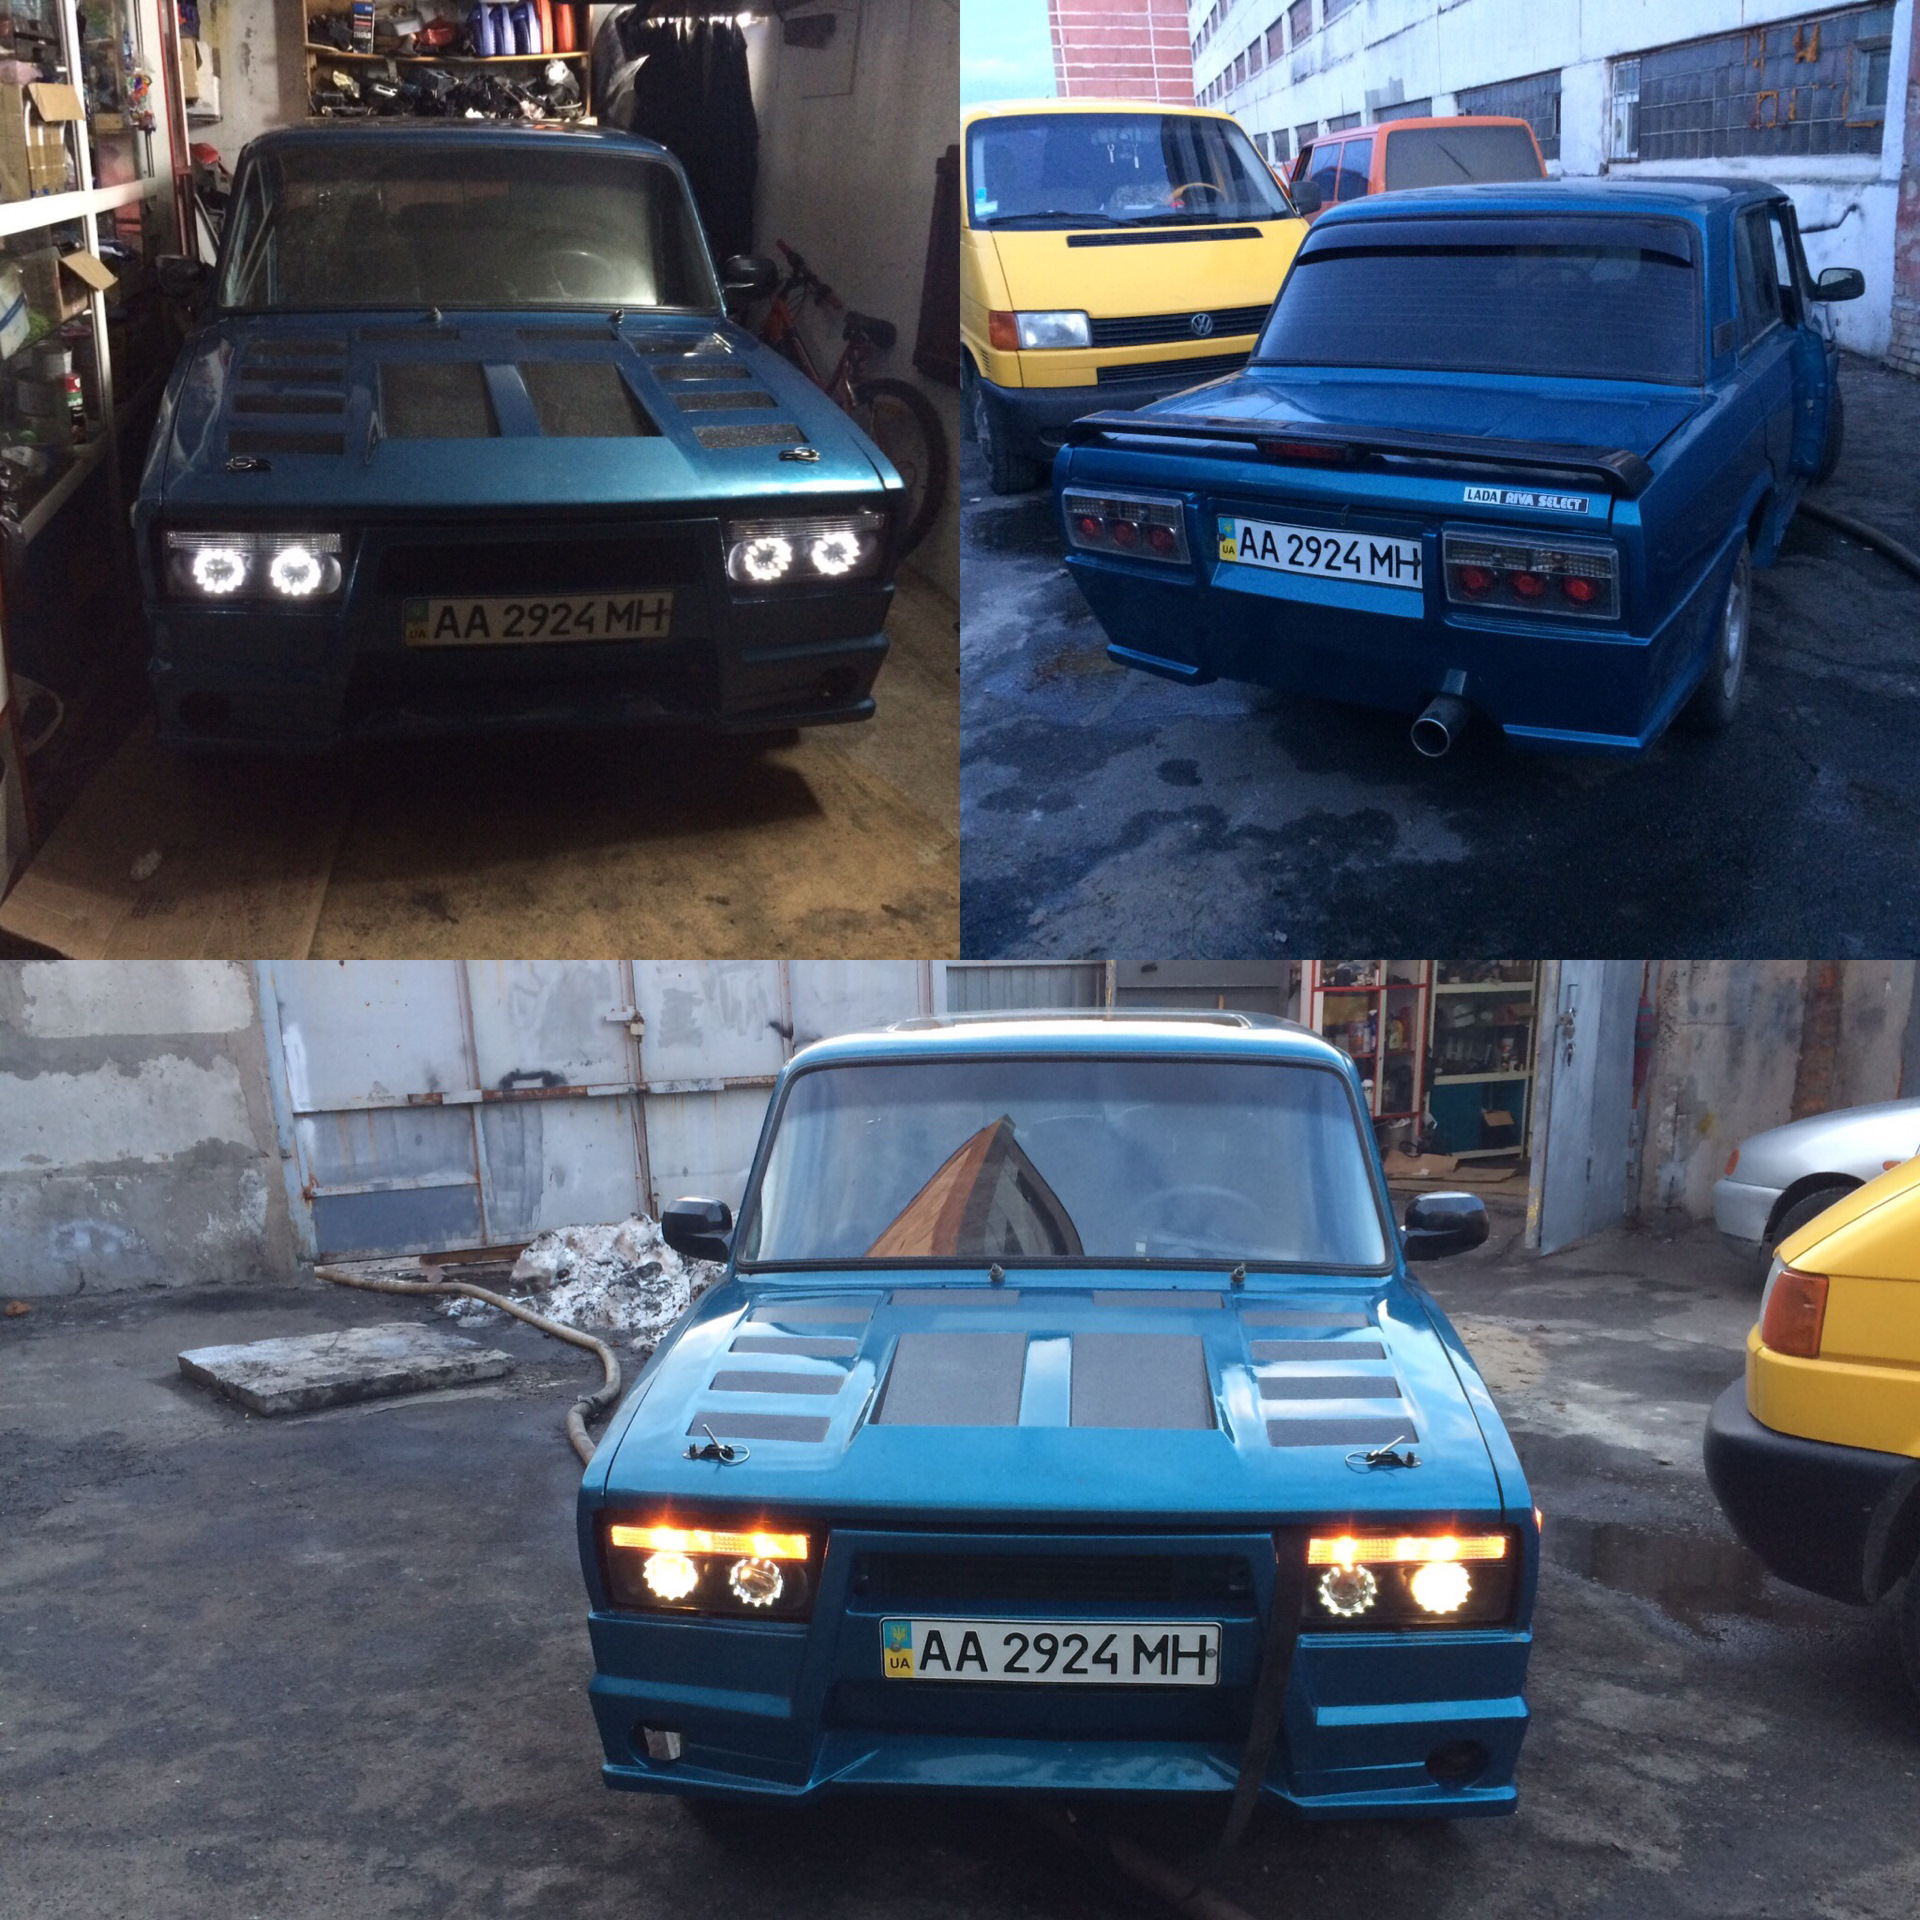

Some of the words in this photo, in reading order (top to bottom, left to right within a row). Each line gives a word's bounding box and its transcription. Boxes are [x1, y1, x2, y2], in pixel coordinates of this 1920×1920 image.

[1191, 313, 1213, 335] VW
[1467, 488, 1498, 503] LADA
[1505, 492, 1534, 506] RIVA
[1537, 495, 1582, 511] SELECT
[1222, 544, 1235, 555] UA
[1239, 526, 1280, 563] AA
[1287, 533, 1361, 574] 2924
[1369, 542, 1420, 581] MH
[433, 605, 491, 639] AA
[503, 601, 595, 638] 2924
[604, 598, 665, 633] MH
[408, 630, 426, 640] UA
[919, 1629, 988, 1673] AA
[1003, 1632, 1118, 1675] 2924
[1132, 1633, 1208, 1676] MH
[889, 1657, 911, 1671] UA
